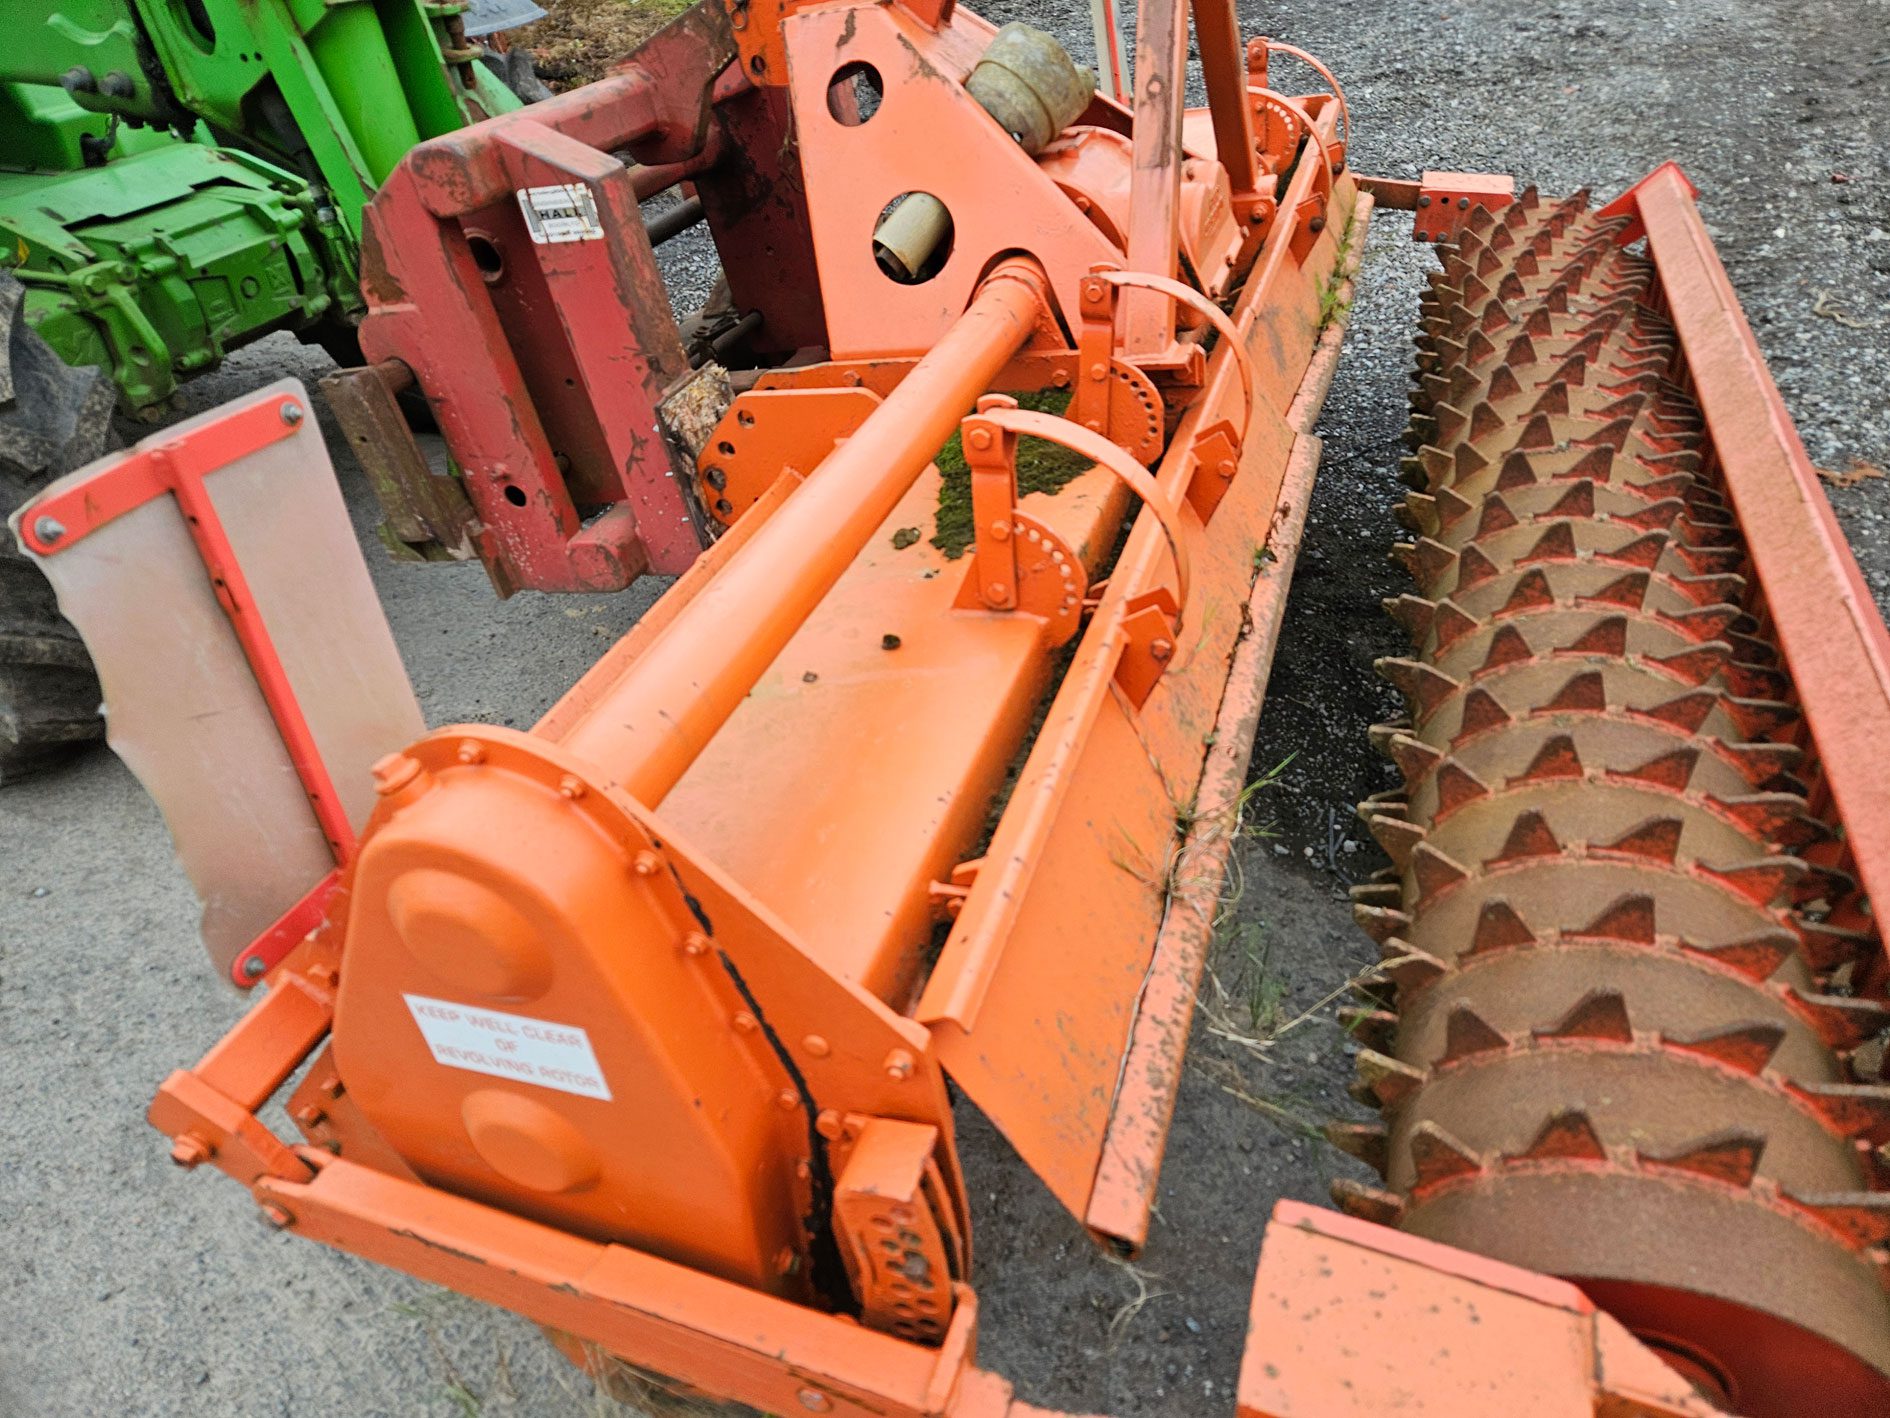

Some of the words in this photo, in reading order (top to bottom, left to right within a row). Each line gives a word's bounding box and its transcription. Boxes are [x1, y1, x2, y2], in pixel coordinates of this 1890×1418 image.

[416, 1003, 460, 1022] KEEP
[465, 1014, 519, 1036] WELL
[521, 1025, 583, 1050] CLEAR
[494, 1038, 519, 1053] OF
[434, 1044, 534, 1075] REVOLVING
[538, 1065, 601, 1089] ROTOR
